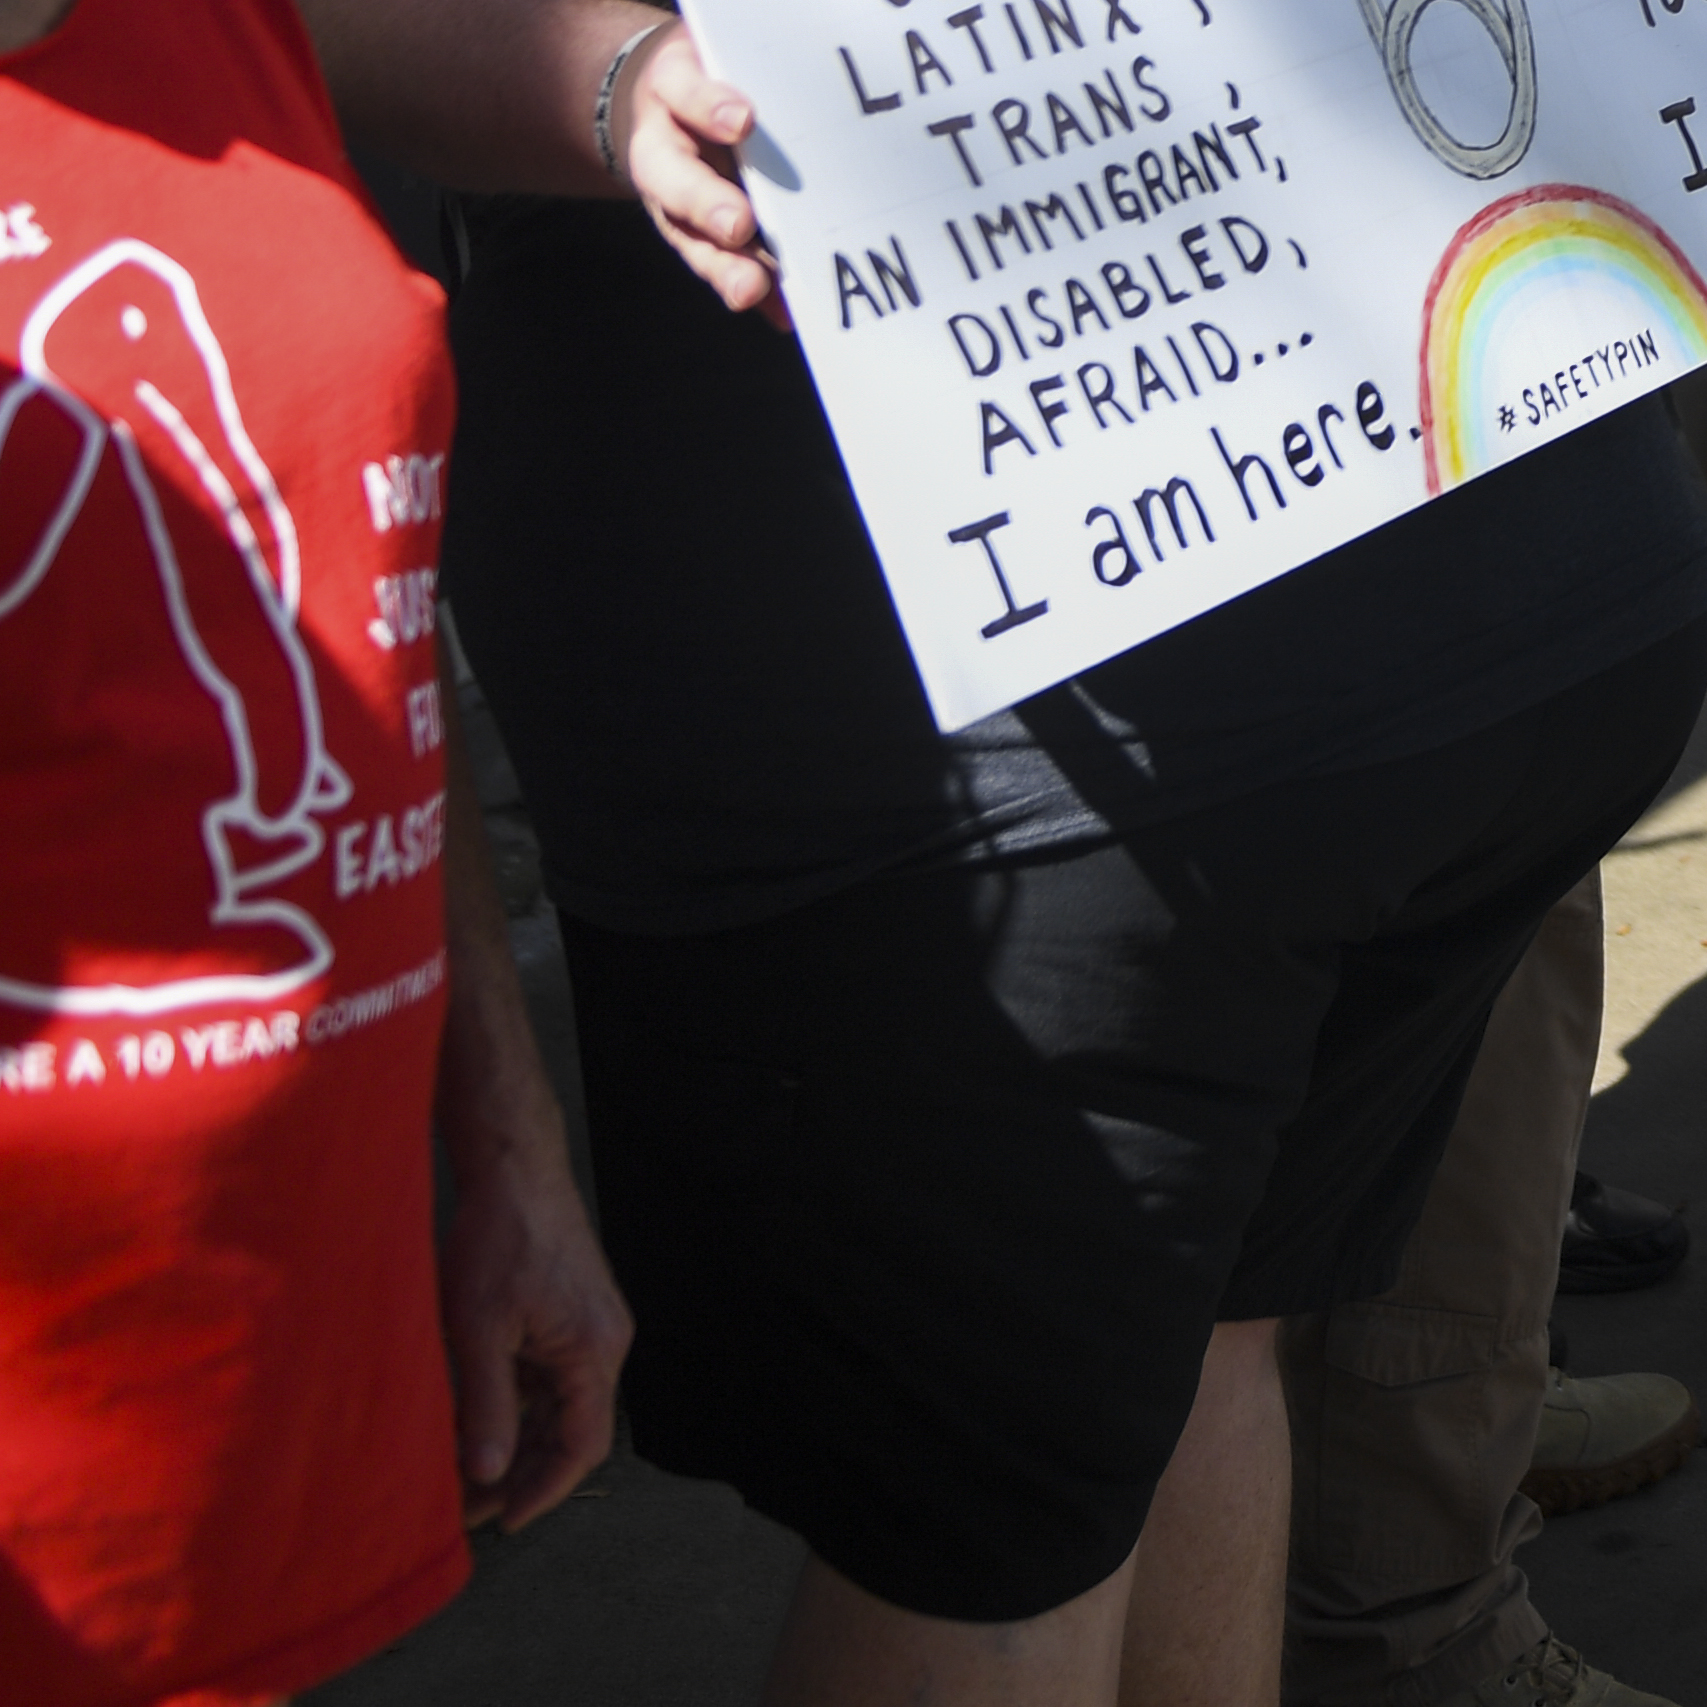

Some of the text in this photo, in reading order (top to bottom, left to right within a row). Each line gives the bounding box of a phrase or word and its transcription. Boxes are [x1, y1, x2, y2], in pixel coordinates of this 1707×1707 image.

[831, 115, 1290, 330] AN IMMIGRANT,
[947, 214, 1308, 378] DISABLED,
[977, 321, 1314, 476] AFRAID...
[947, 381, 1424, 639] I am here.
[367, 567, 440, 650] JUS
[66, 1037, 107, 1089] A
[116, 1028, 176, 1081] 10
[179, 1009, 300, 1072] YEAR
